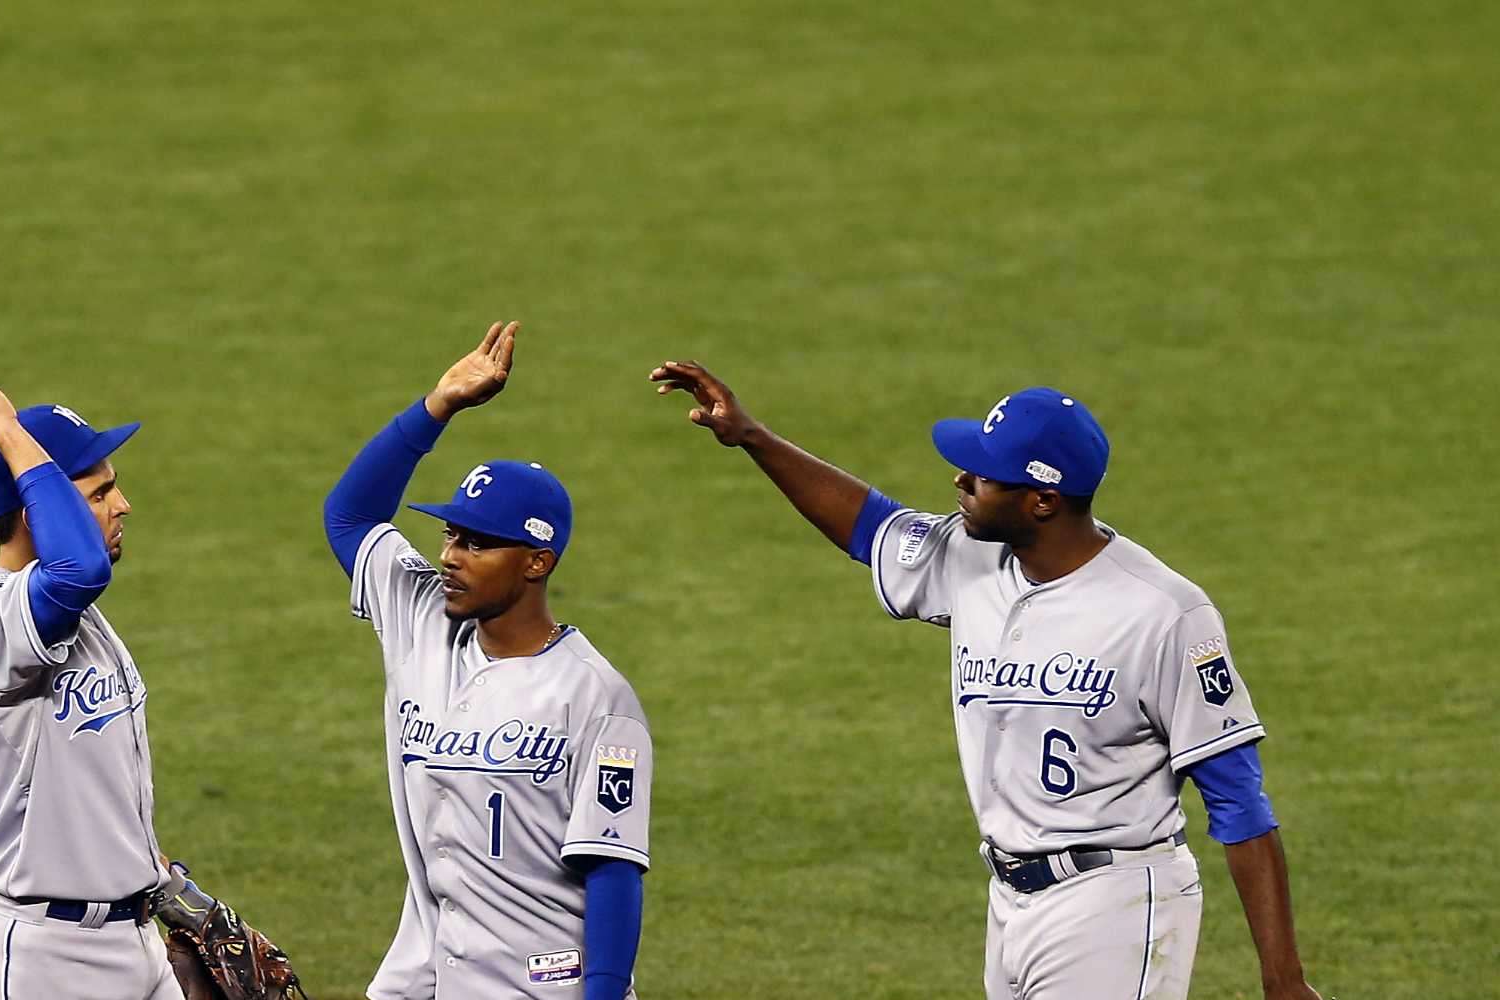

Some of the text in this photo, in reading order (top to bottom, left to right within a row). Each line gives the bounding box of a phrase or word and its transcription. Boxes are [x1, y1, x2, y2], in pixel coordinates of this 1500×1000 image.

[1039, 651, 1117, 718] City
[1199, 665, 1231, 694] KC
[399, 699, 569, 785] Kanas City
[1040, 727, 1078, 797] 6
[599, 769, 630, 805] KC
[487, 792, 504, 859] 1
